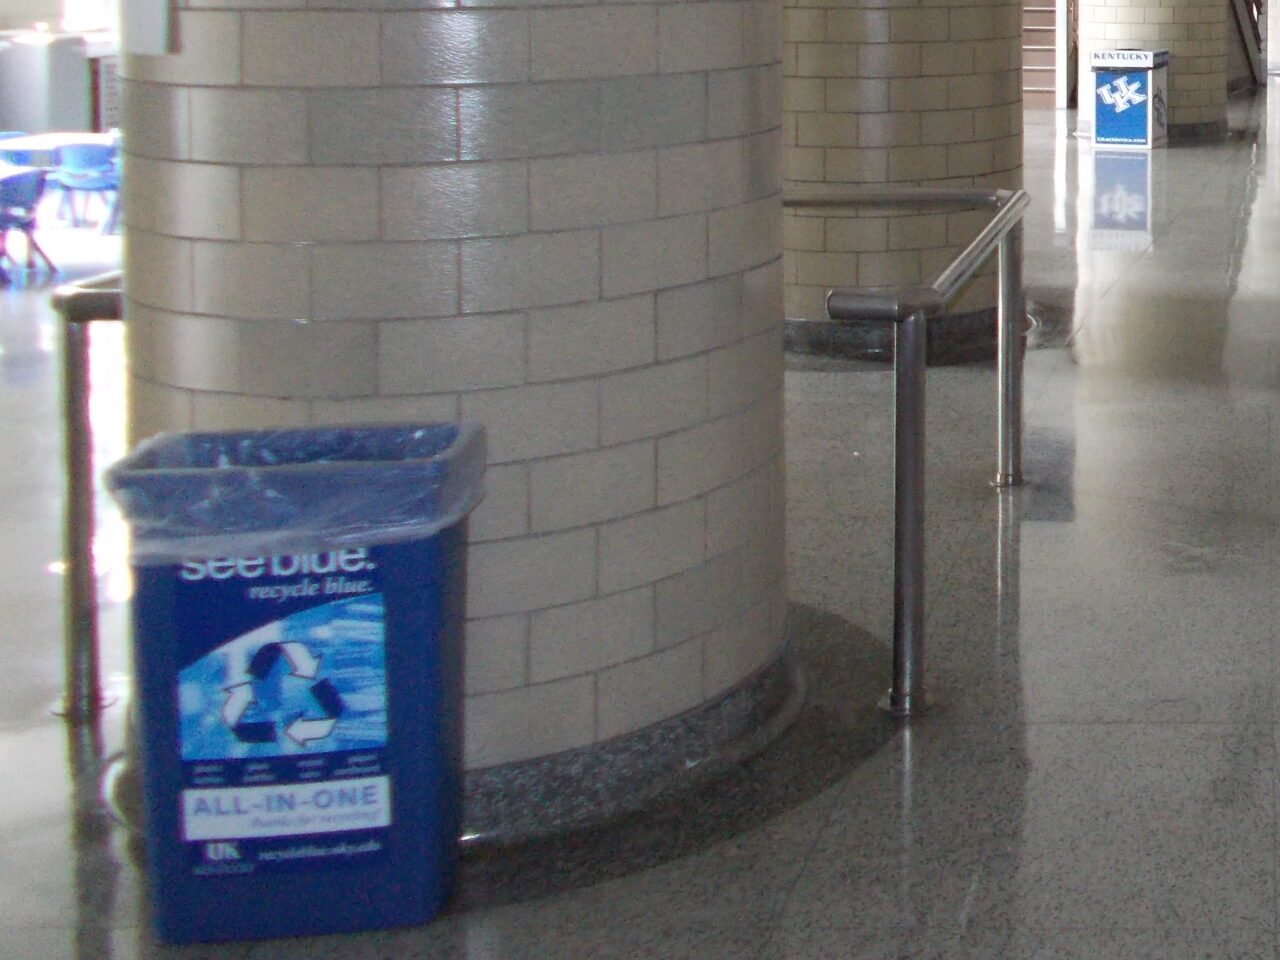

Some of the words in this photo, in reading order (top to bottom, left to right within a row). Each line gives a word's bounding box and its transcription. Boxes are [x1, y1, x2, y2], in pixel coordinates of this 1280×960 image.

[1093, 52, 1150, 60] KENTUCKY
[1096, 76, 1148, 113] UK
[181, 556, 265, 581] see
[249, 578, 319, 602] recycle
[193, 784, 379, 816] ALL-IN-ONE
